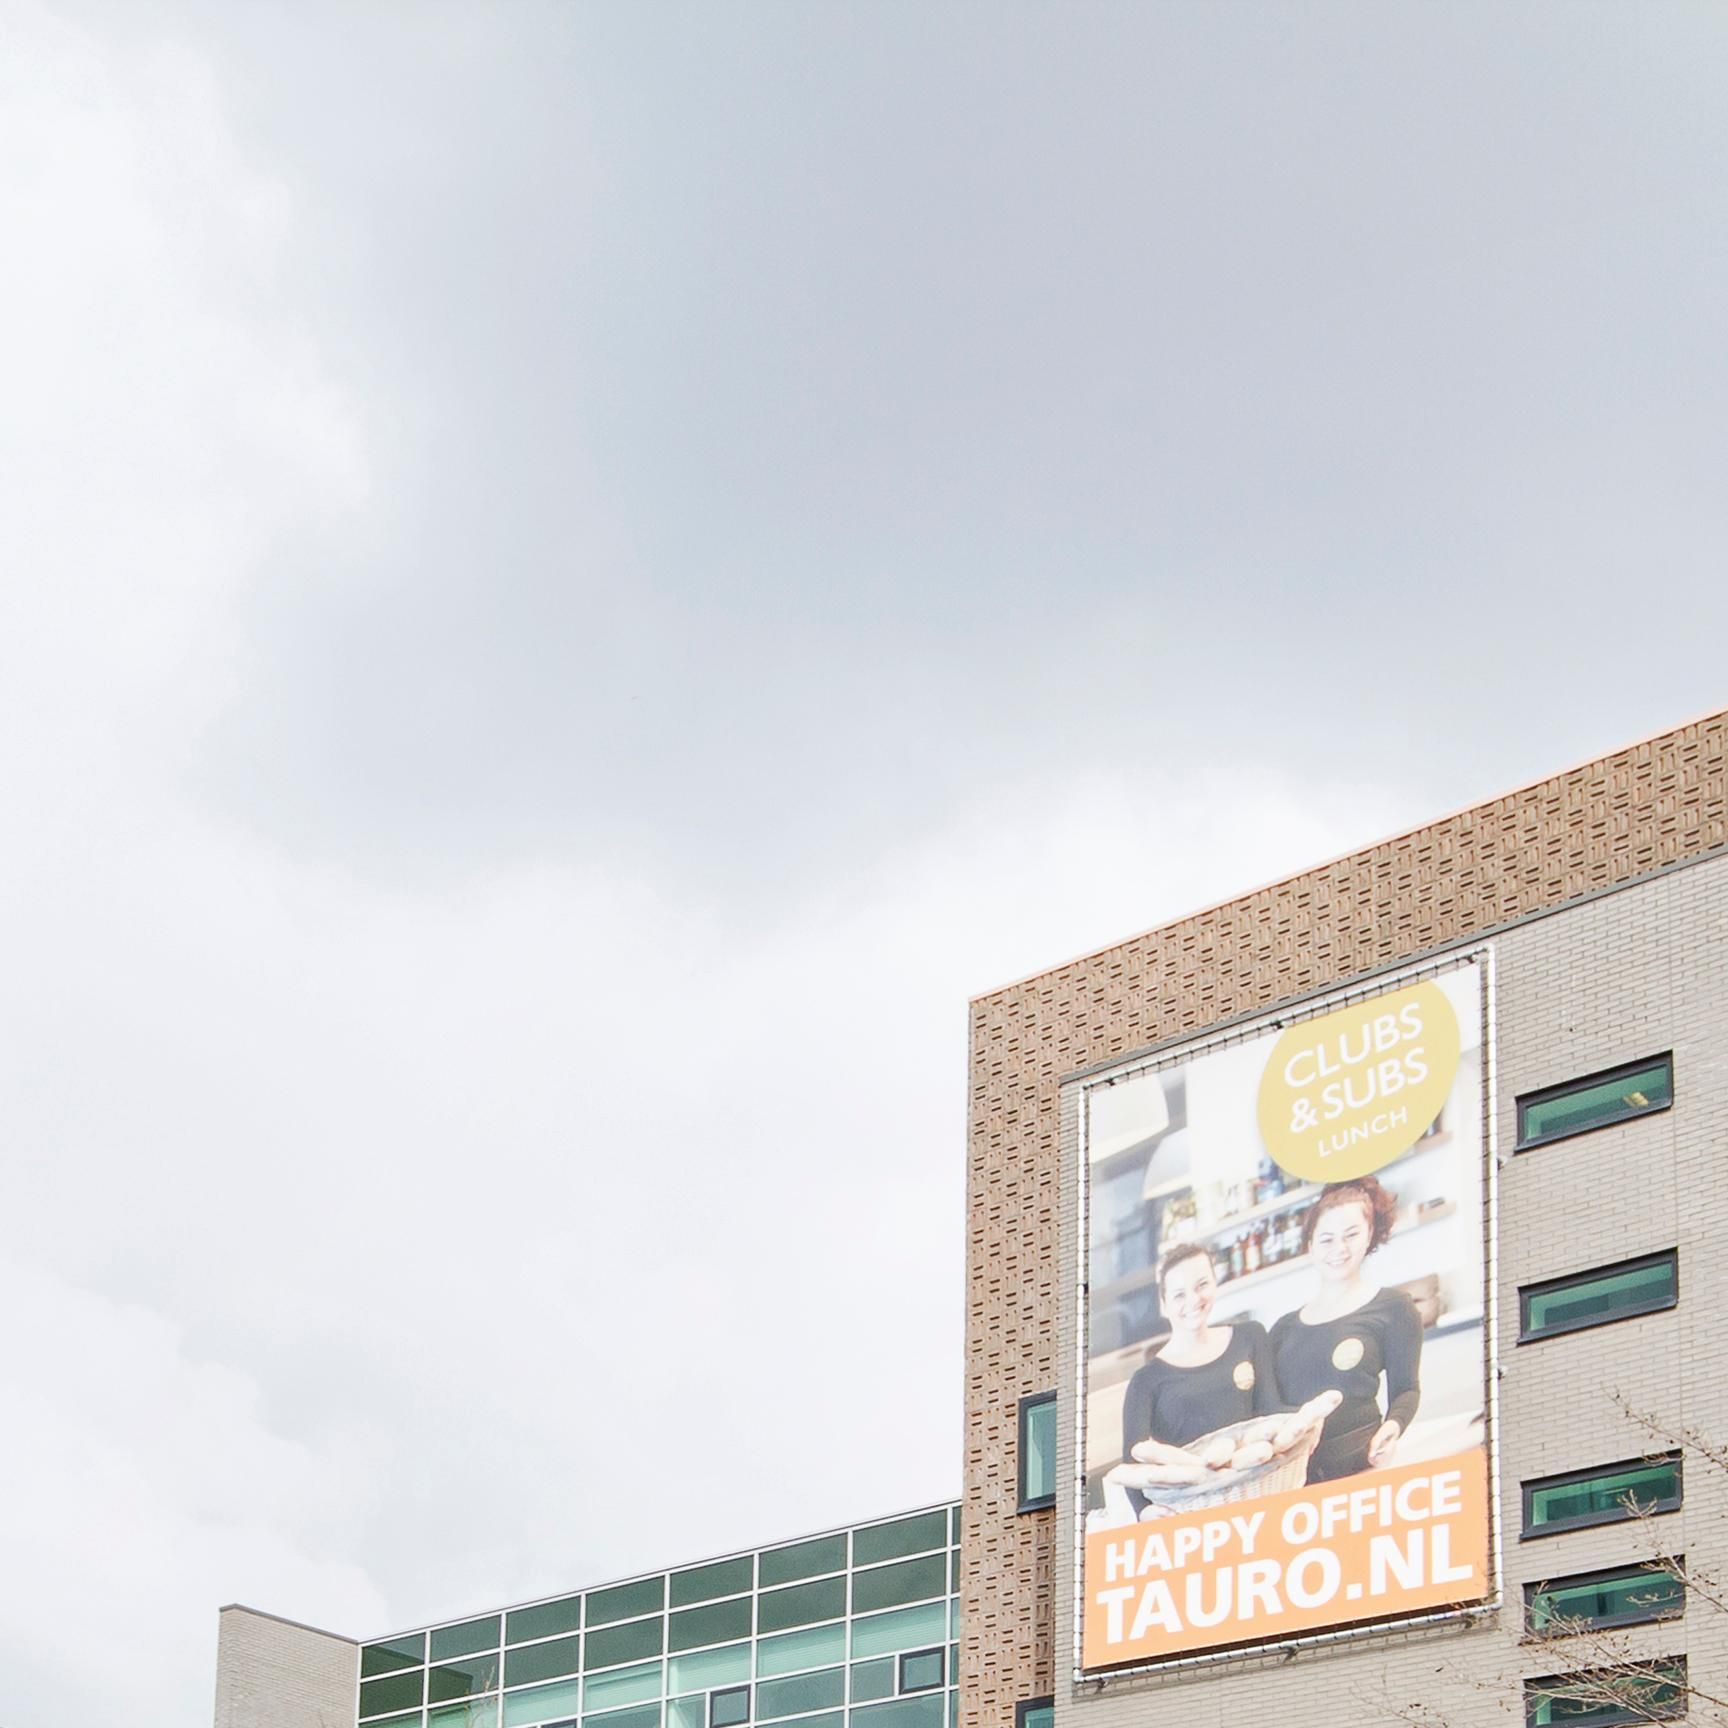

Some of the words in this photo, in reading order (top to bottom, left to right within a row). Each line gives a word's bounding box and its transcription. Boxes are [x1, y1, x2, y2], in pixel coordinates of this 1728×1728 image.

[1283, 1003, 1424, 1090] CLUBS
[1317, 1105, 1408, 1158] LUNCH
[1104, 1511, 1265, 1583] HAPPY
[1280, 1469, 1462, 1547] OFFICE
[1096, 1522, 1473, 1645] TAURO.NL
